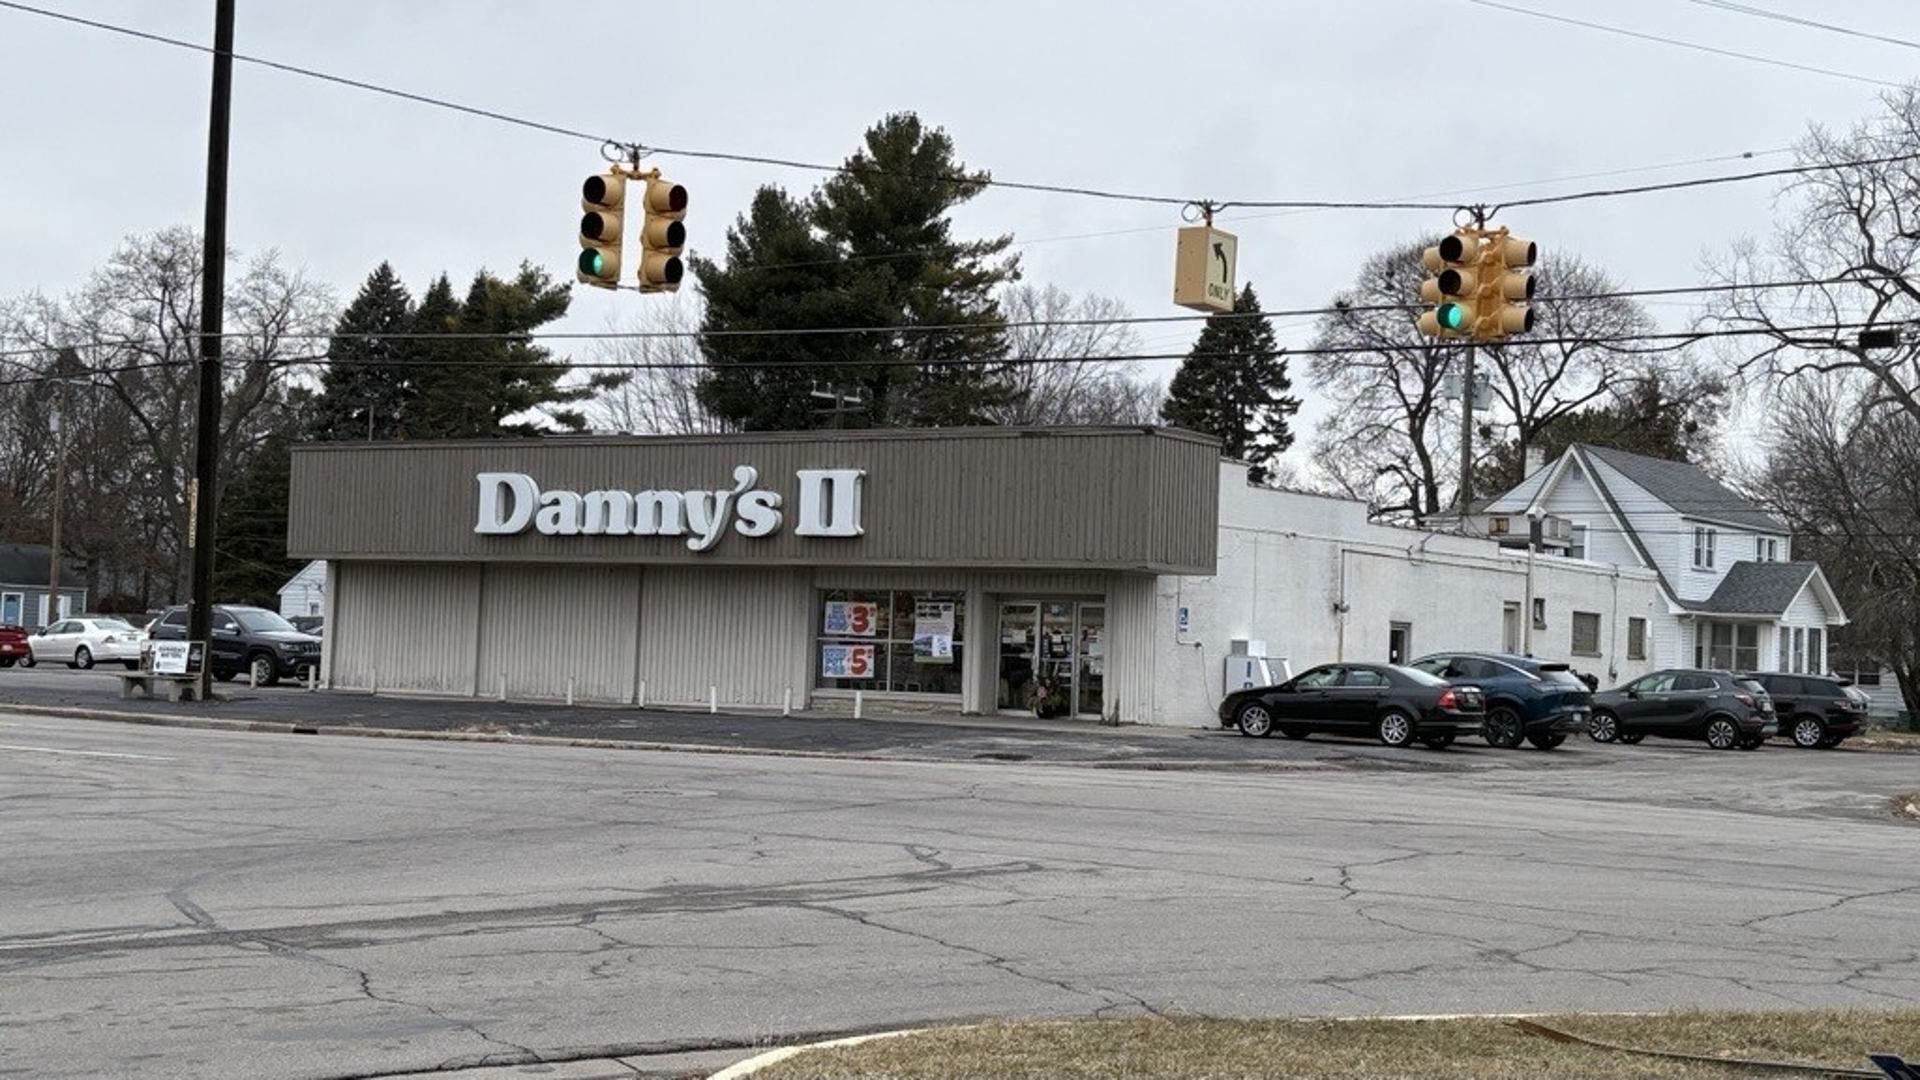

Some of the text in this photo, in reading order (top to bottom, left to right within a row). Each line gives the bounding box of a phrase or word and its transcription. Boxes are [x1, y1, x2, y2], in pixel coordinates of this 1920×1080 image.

[1208, 283, 1230, 300] ONLY
[474, 465, 867, 551] Danny's II
